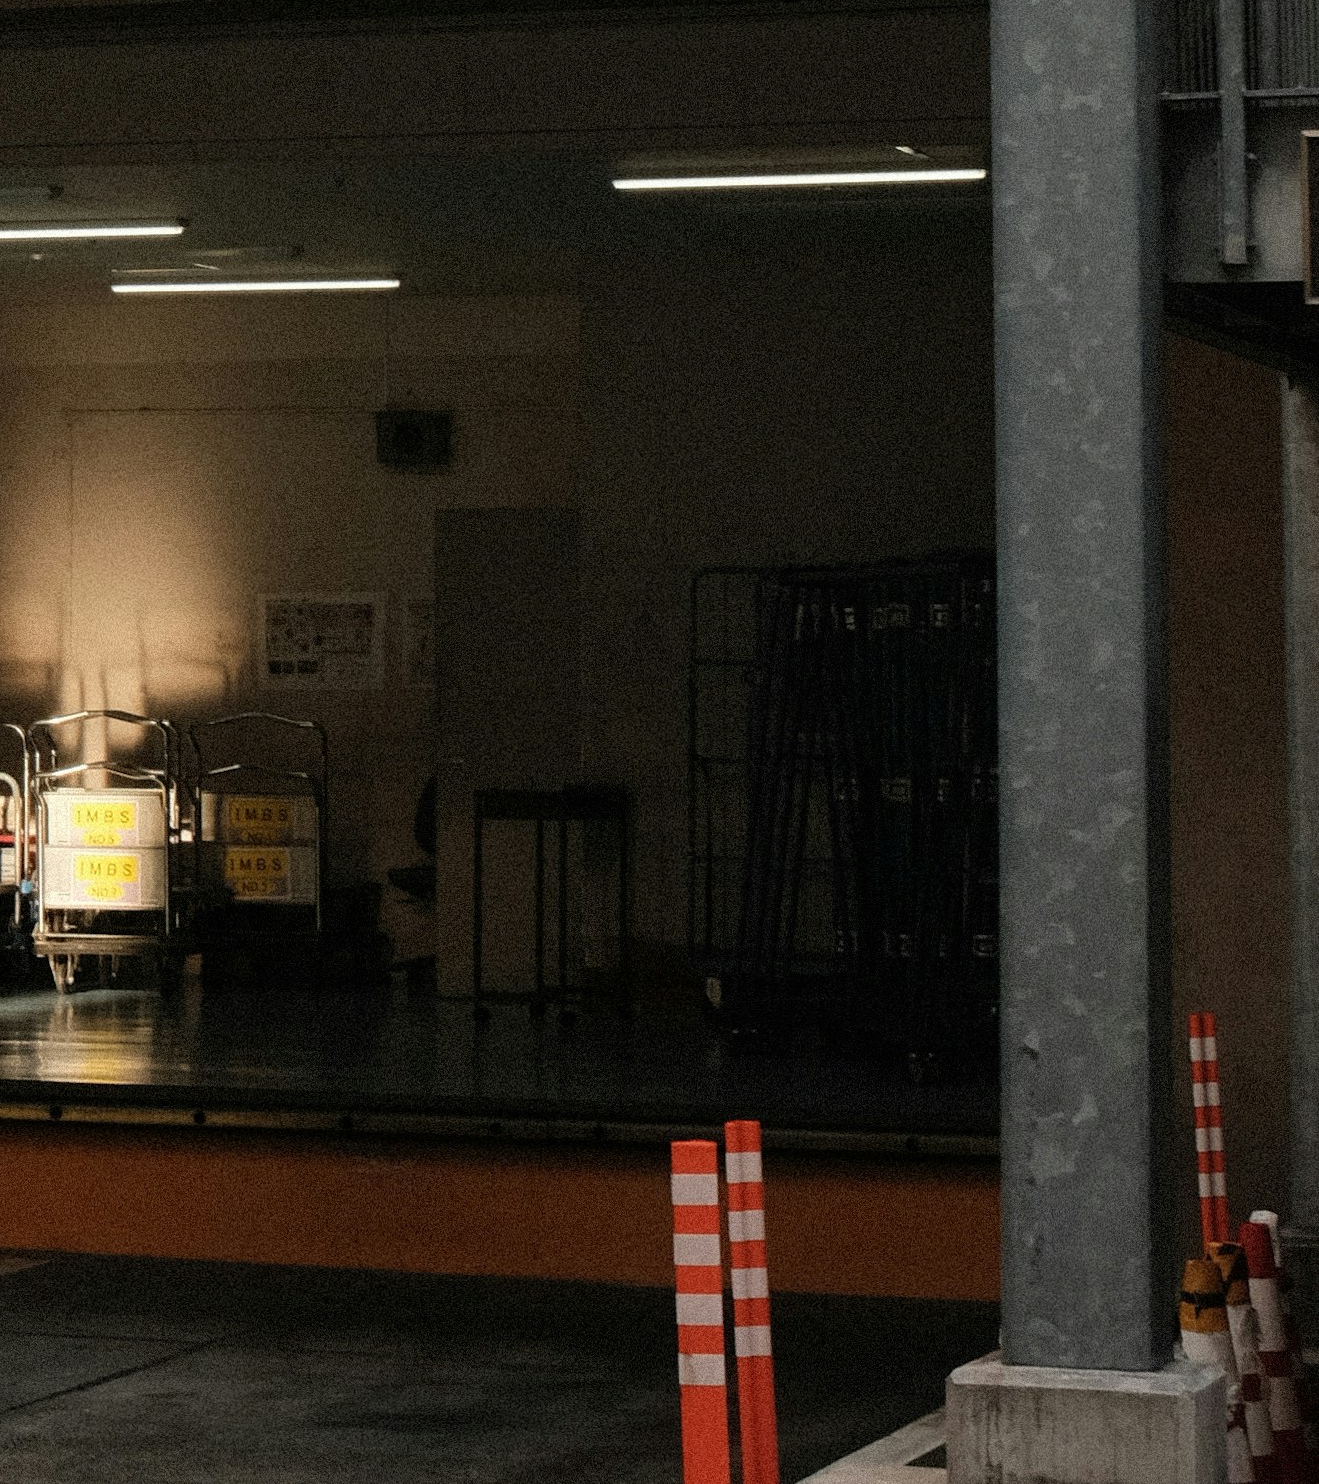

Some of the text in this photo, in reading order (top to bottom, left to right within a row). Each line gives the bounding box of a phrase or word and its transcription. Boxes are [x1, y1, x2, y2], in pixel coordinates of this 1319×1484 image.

[76, 810, 130, 823] IMBS
[80, 863, 133, 877] IMBS
[229, 858, 282, 871] IMBS
